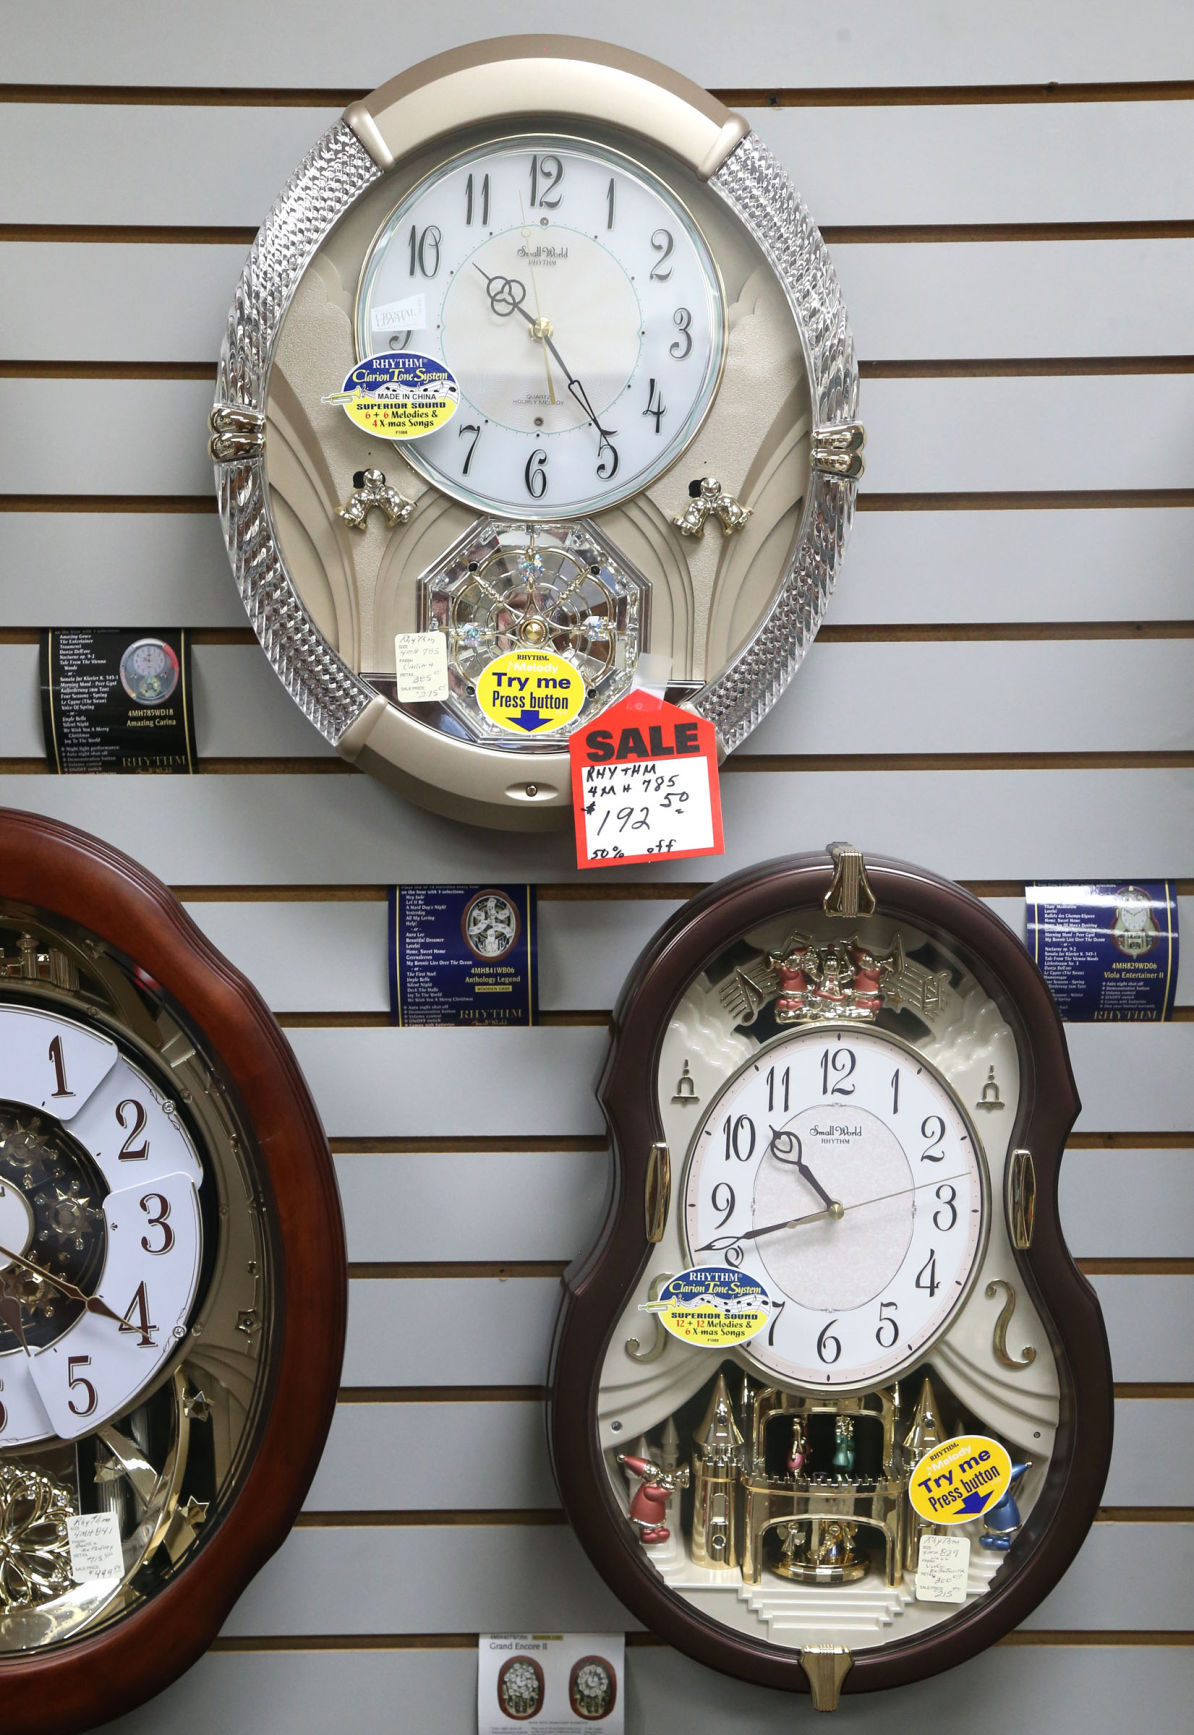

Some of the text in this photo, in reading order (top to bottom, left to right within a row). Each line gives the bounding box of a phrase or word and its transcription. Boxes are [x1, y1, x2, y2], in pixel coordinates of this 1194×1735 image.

[466, 174, 491, 225] 11
[530, 155, 564, 208] 12
[606, 178, 615, 229] 1
[409, 225, 442, 278] 10
[650, 229, 674, 281] 2
[670, 308, 692, 359] 3
[352, 368, 448, 383] Clarion Tone System
[365, 411, 370, 419] 6
[391, 410, 429, 418] Melodies
[432, 410, 438, 418] &
[372, 419, 377, 427] 4
[408, 419, 434, 428] Songs
[642, 379, 666, 433] 4
[459, 425, 480, 474] 7
[597, 428, 618, 480] 5
[525, 449, 547, 498] 6
[492, 673, 571, 691] Try me
[514, 662, 558, 674] Melody
[493, 691, 568, 710] Press button
[586, 722, 700, 762] SALE
[586, 764, 656, 782] RHYTHM
[590, 839, 676, 860] 50% off
[465, 976, 495, 984] Anthology
[48, 1034, 76, 1097] 1
[766, 1065, 791, 1112] 11
[821, 1048, 856, 1096] 12
[891, 1068, 900, 1114] 1
[115, 1099, 149, 1161] 2
[723, 1114, 756, 1162] 10
[810, 1125, 862, 1137] Small World
[921, 1115, 946, 1162] 2
[139, 1193, 175, 1255] 3
[711, 1182, 735, 1230] 9
[933, 1184, 957, 1232] 3
[669, 1281, 761, 1296] Clarion Tone System
[915, 1248, 940, 1298] 4
[118, 1280, 159, 1348] 4
[721, 1328, 745, 1338] Songs
[769, 1301, 785, 1346] 7
[876, 1301, 899, 1348] 5
[817, 1319, 842, 1364] 6
[67, 1354, 97, 1417] 5
[918, 1450, 991, 1493] Try me
[930, 1442, 957, 1462] RHYTHM
[932, 1445, 972, 1473] Melody
[928, 1465, 1000, 1512] Press button
[489, 1642, 513, 1650] Grand
